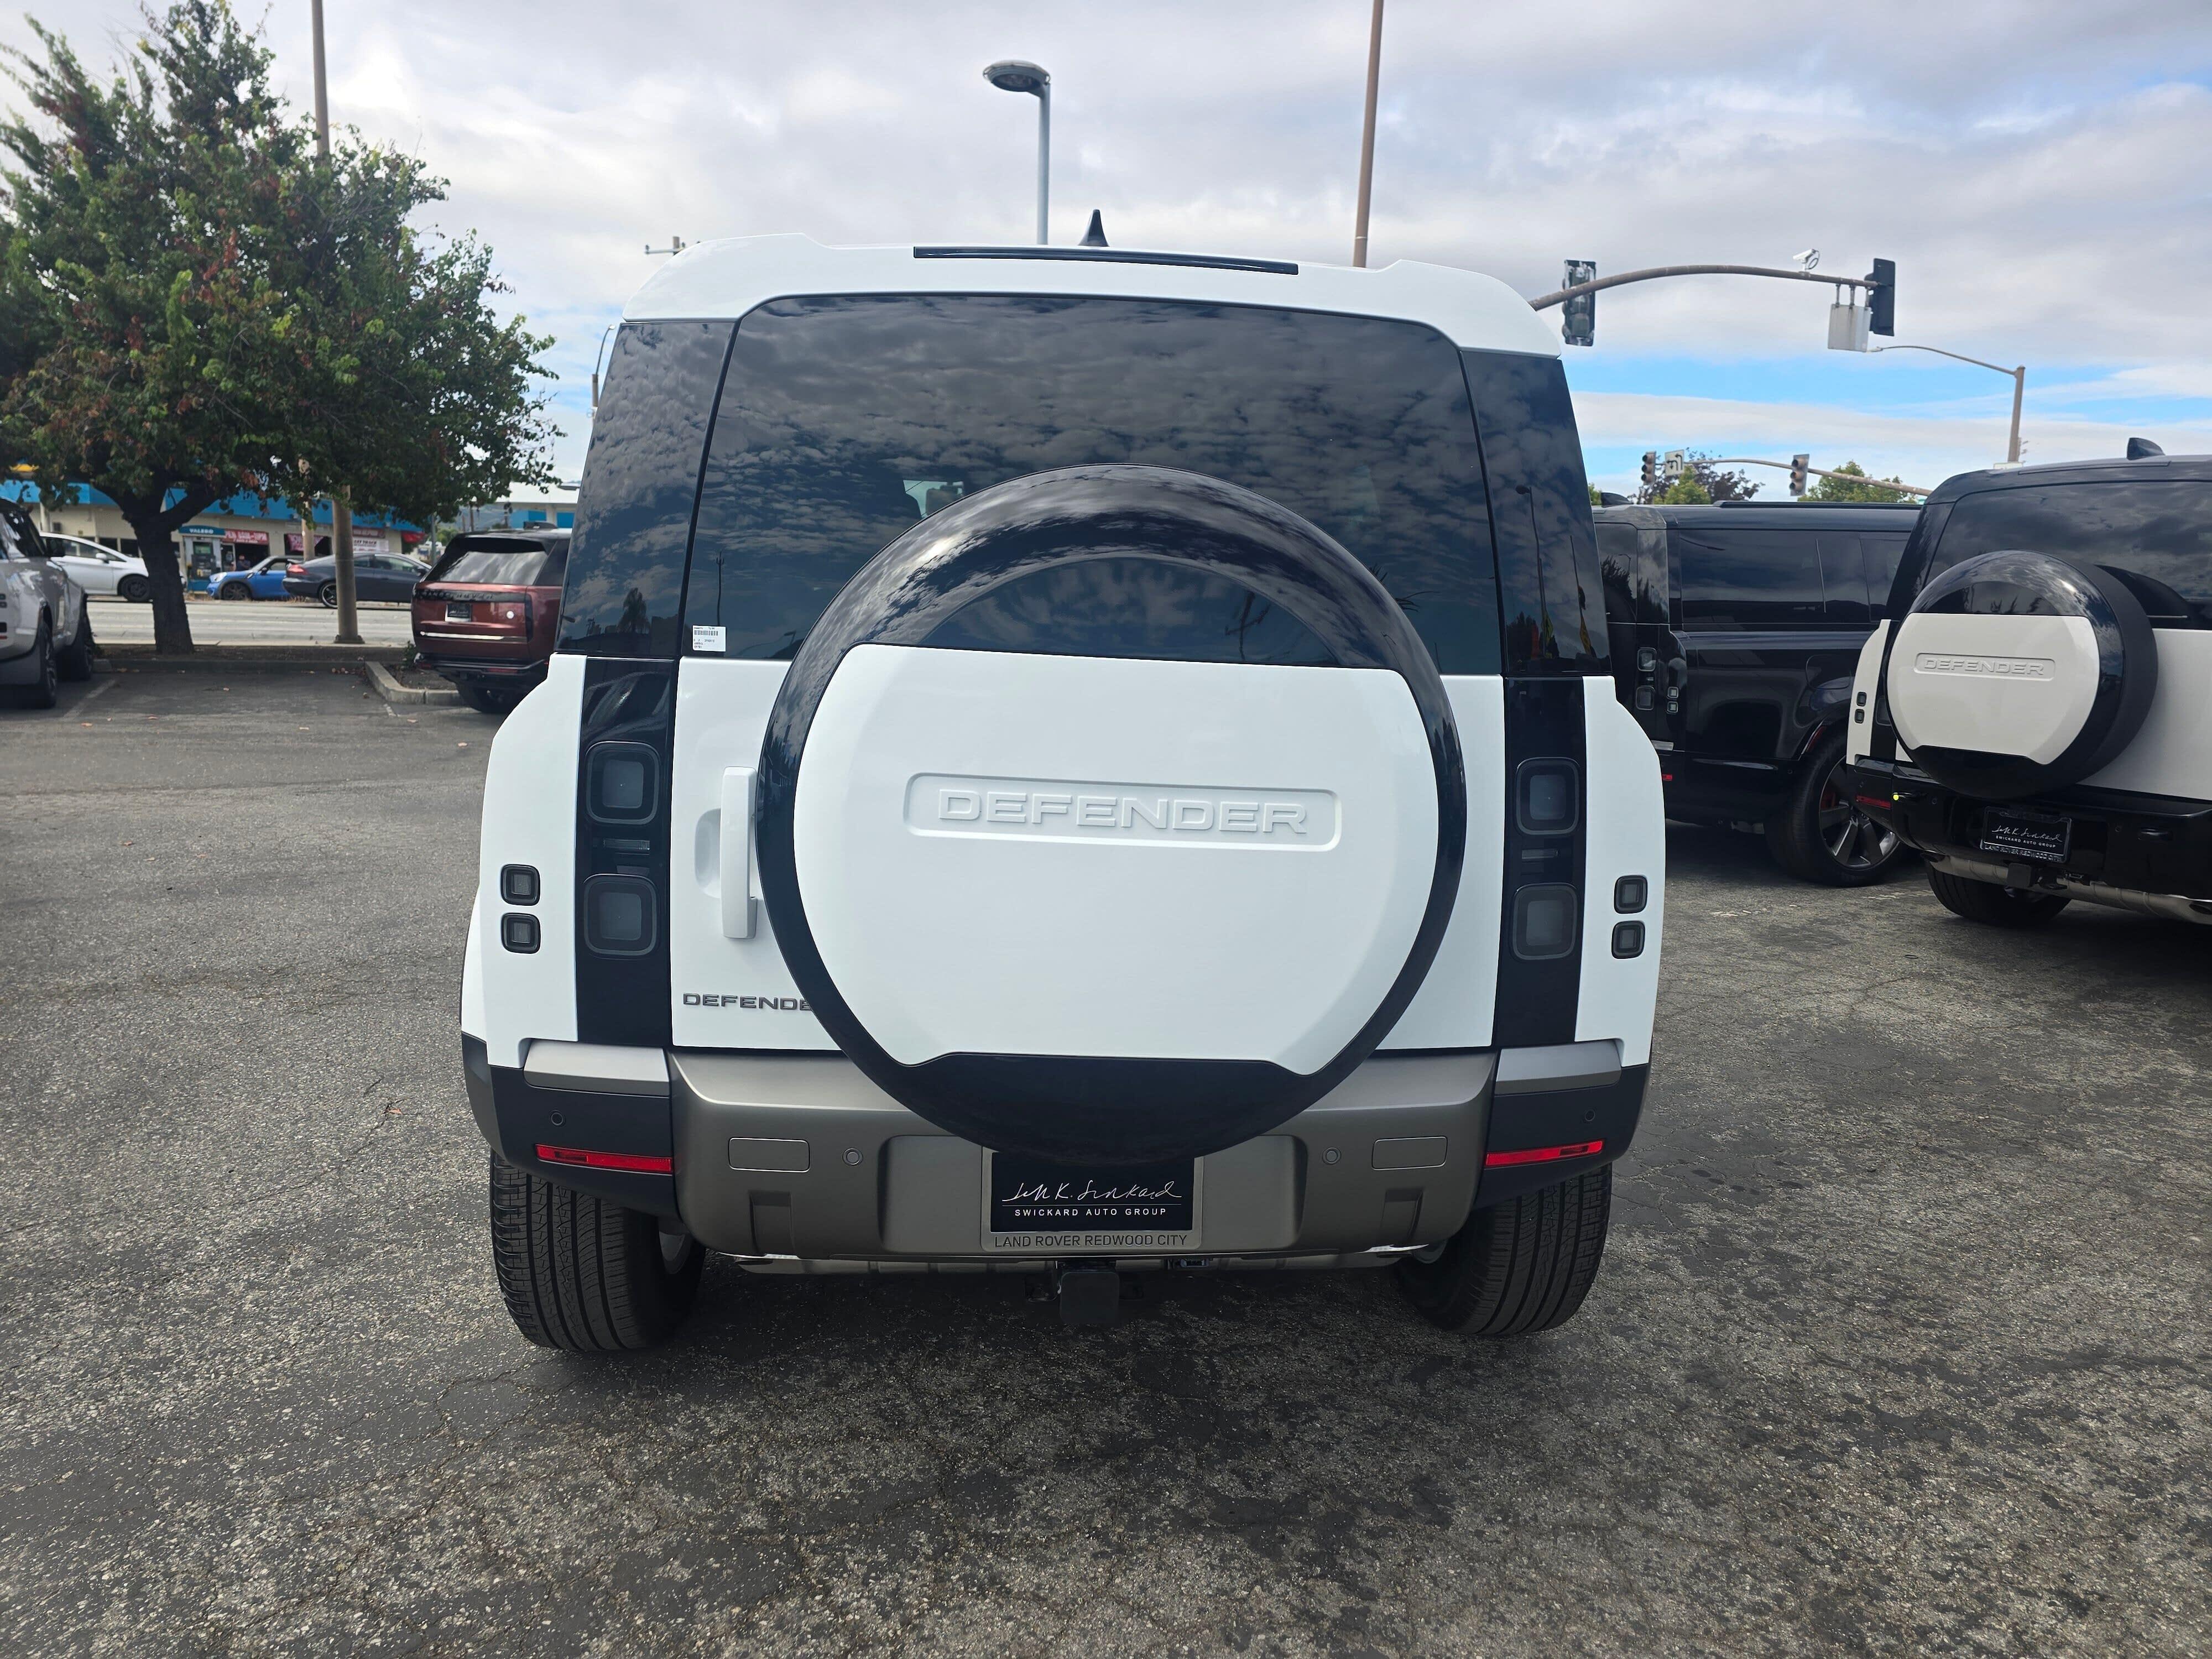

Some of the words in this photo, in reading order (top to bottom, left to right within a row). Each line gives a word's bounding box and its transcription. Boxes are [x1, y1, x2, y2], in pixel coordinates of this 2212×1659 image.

[1923, 658, 2044, 675] DEFENDER
[938, 789, 1307, 833] DEFENDER
[995, 1236, 1031, 1248] LAND
[1036, 1235, 1080, 1246] ROVER
[1084, 1235, 1153, 1246] REDWOOD
[1157, 1235, 1187, 1245] CITY
